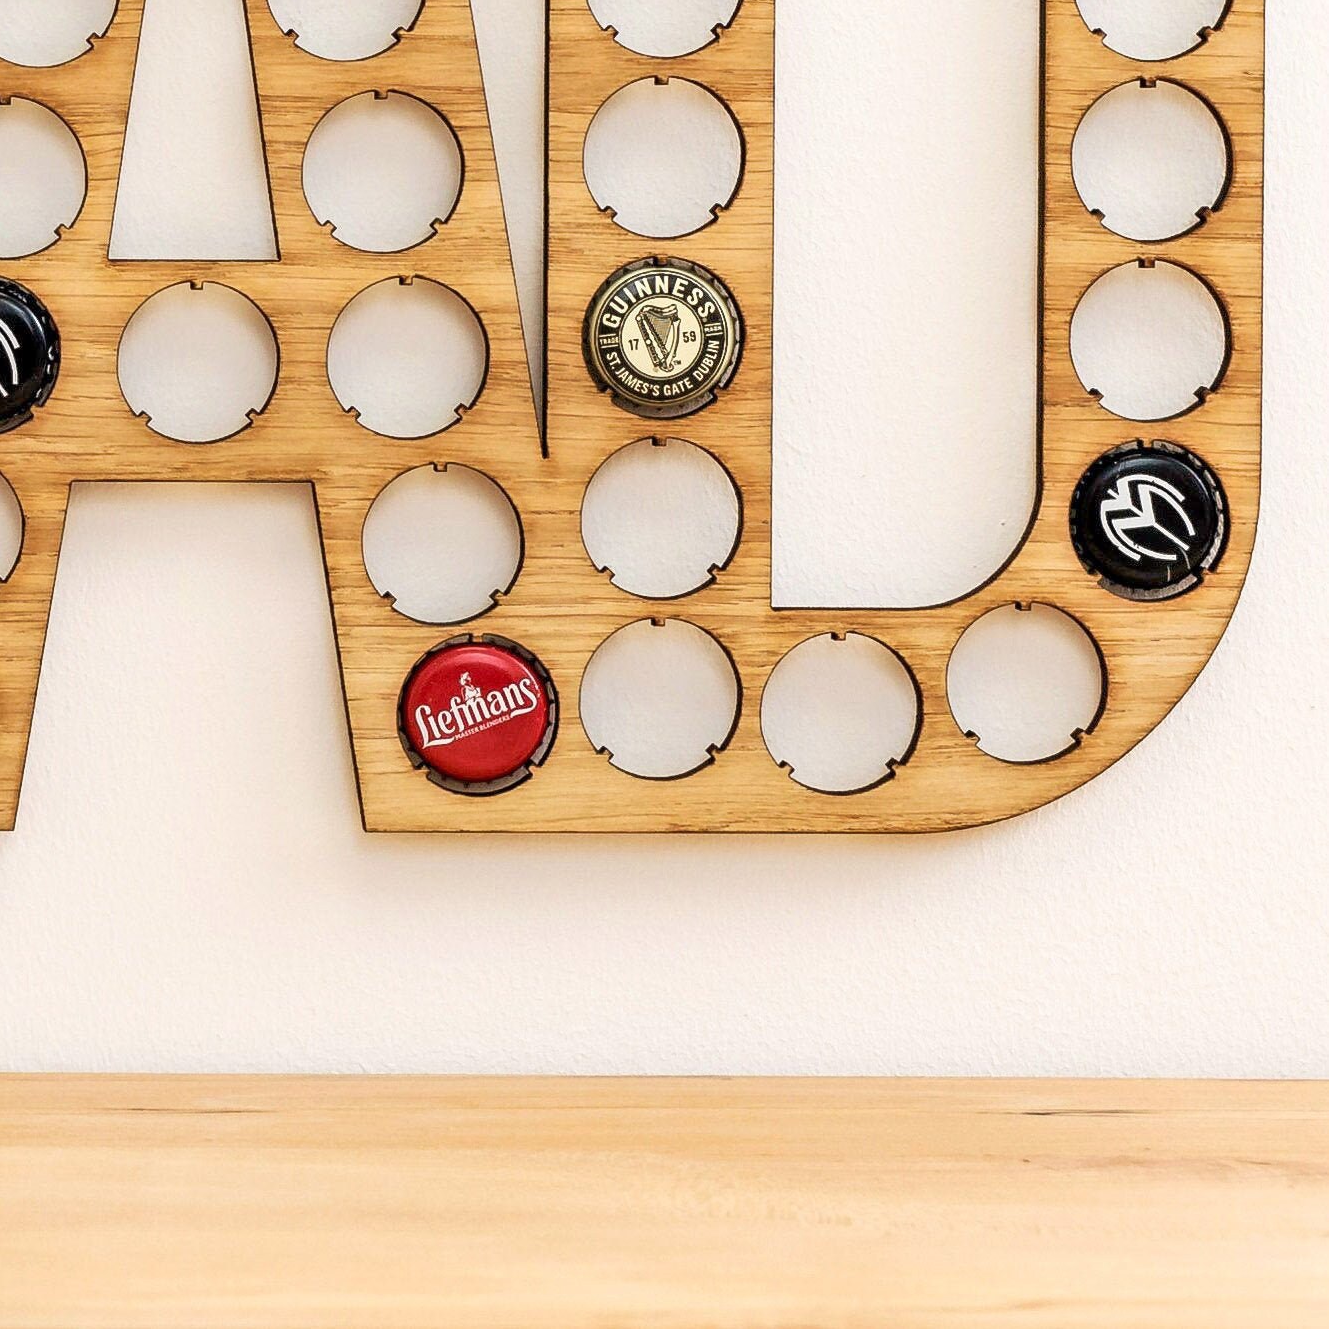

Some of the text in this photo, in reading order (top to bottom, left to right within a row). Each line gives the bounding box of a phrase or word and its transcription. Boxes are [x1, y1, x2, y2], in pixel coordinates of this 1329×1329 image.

[602, 275, 716, 328] GUINNESS
[606, 339, 720, 397] ST. JAMES'S GATE DUBLIN
[627, 330, 697, 351] 17 59
[415, 677, 538, 750] Liefmans
